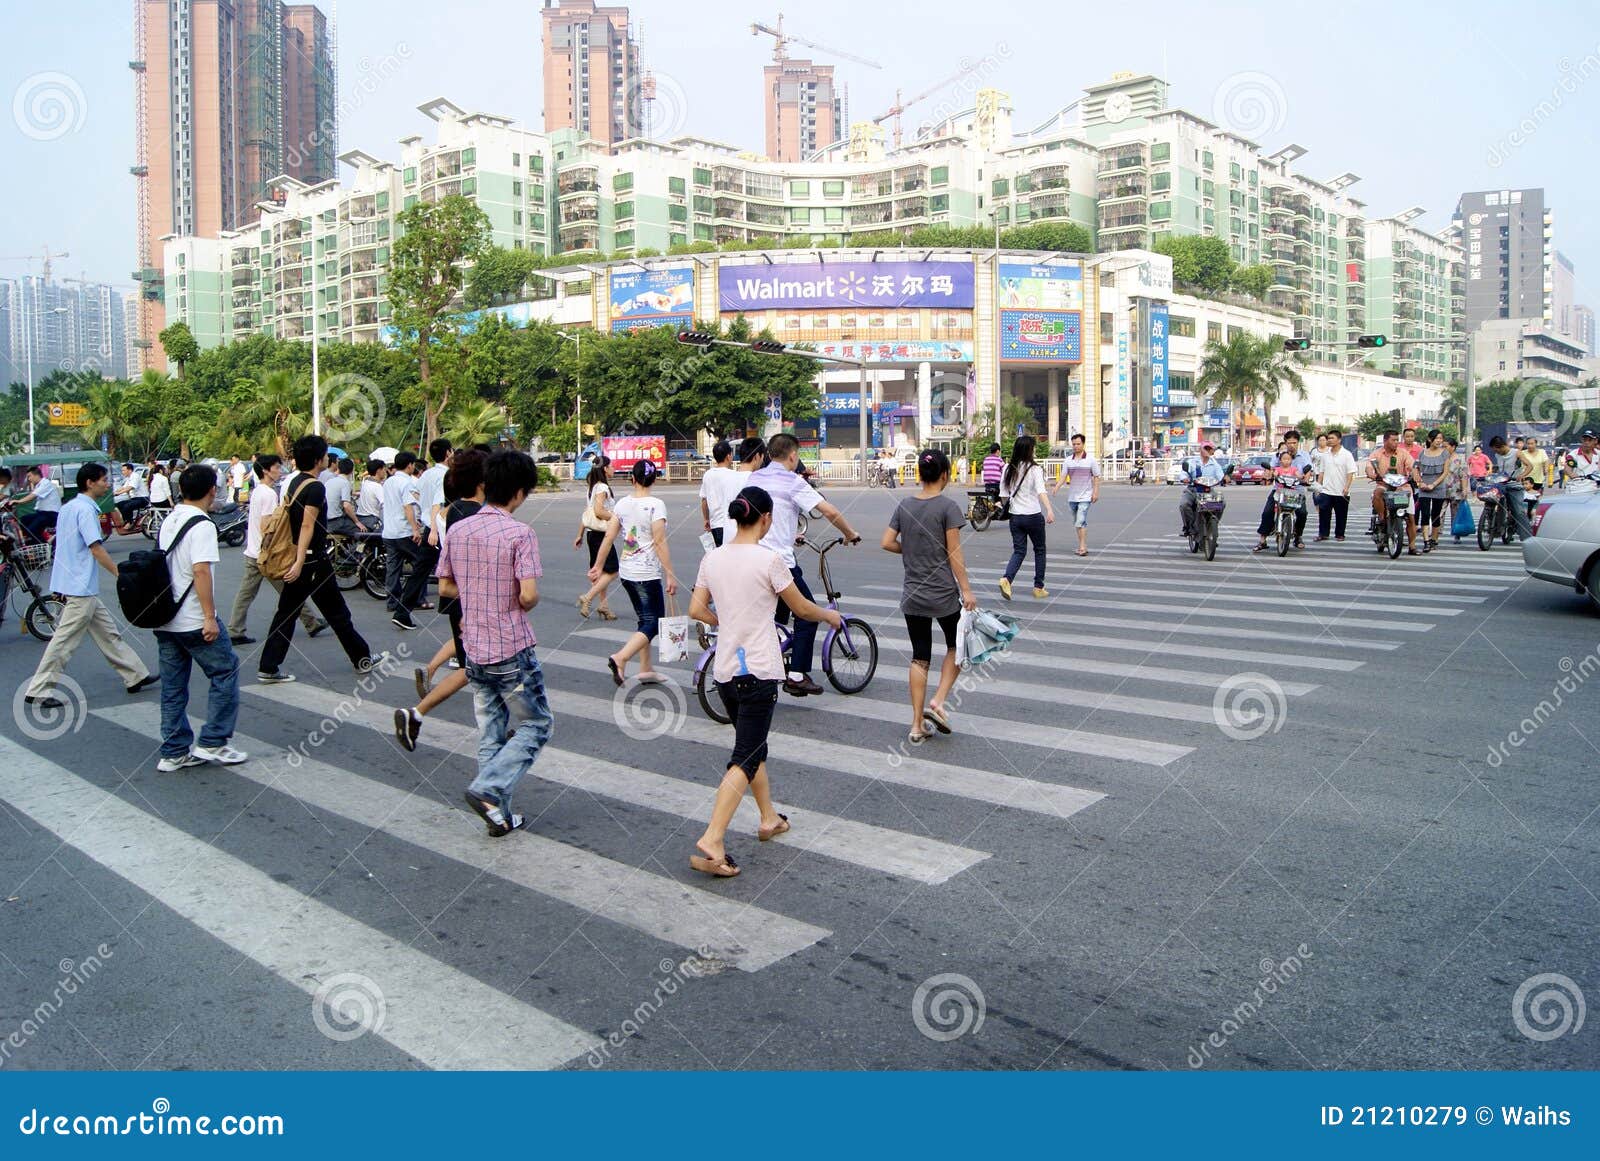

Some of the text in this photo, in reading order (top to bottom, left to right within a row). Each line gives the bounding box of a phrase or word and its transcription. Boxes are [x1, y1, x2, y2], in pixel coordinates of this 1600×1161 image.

[737, 275, 954, 300] Walmart 沃尔玛
[1152, 319, 1164, 402] 战地网吧
